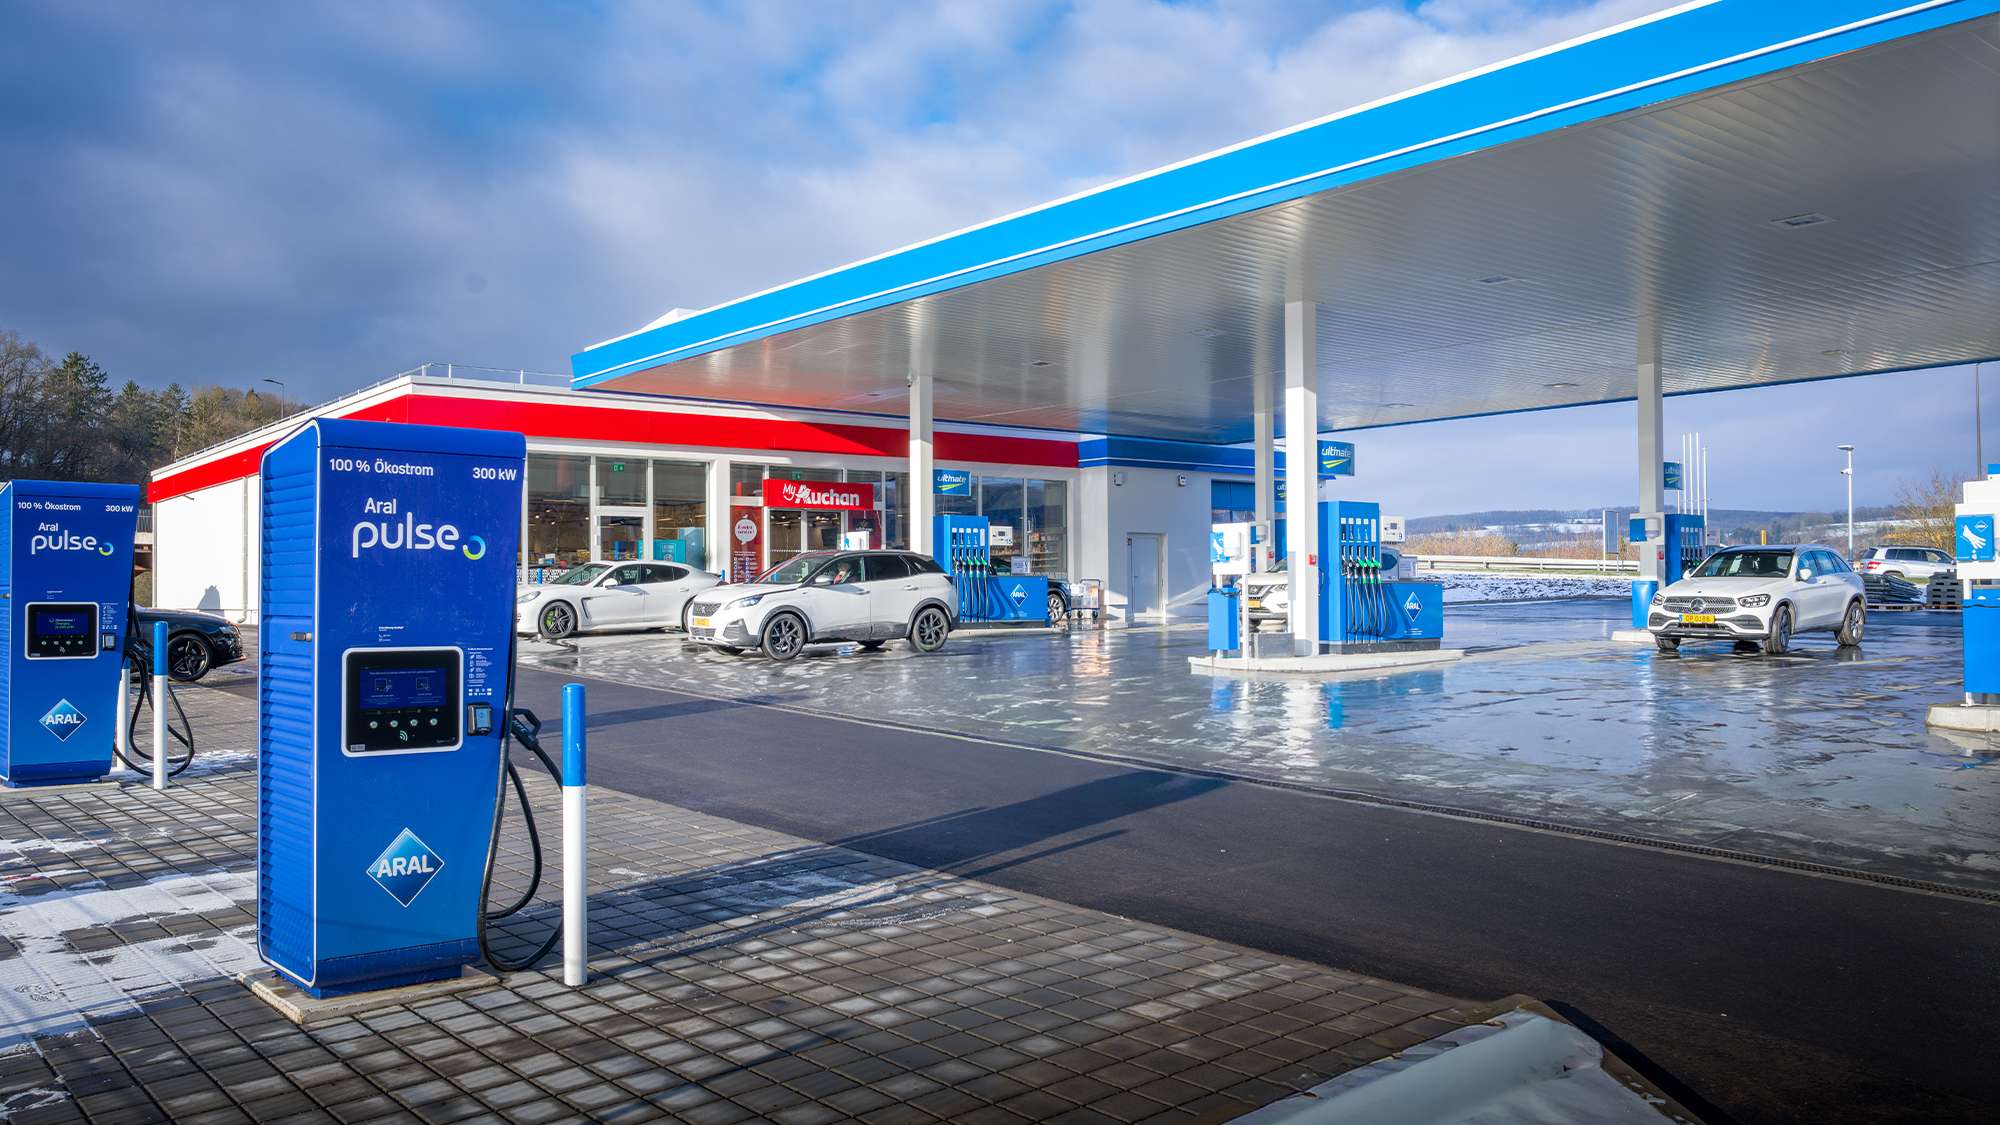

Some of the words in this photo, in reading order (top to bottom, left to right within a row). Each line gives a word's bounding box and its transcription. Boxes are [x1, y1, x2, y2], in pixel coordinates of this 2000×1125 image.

[329, 458, 352, 472] 100
[355, 459, 370, 473] %
[374, 458, 434, 477] Ökostrom
[472, 467, 496, 480] 300
[498, 468, 517, 481] kW
[782, 482, 796, 501] My
[795, 484, 860, 506] Auchan
[17, 502, 32, 510] 100
[33, 502, 43, 510] %
[44, 501, 81, 511] Ökostrom
[105, 504, 121, 512] 300
[122, 505, 134, 513] kW
[364, 497, 397, 514] Aral
[38, 521, 59, 532] Aral
[352, 511, 460, 559] pulse
[31, 529, 97, 555] pulse
[45, 713, 81, 725] ARAL
[376, 854, 434, 878] ARAL
